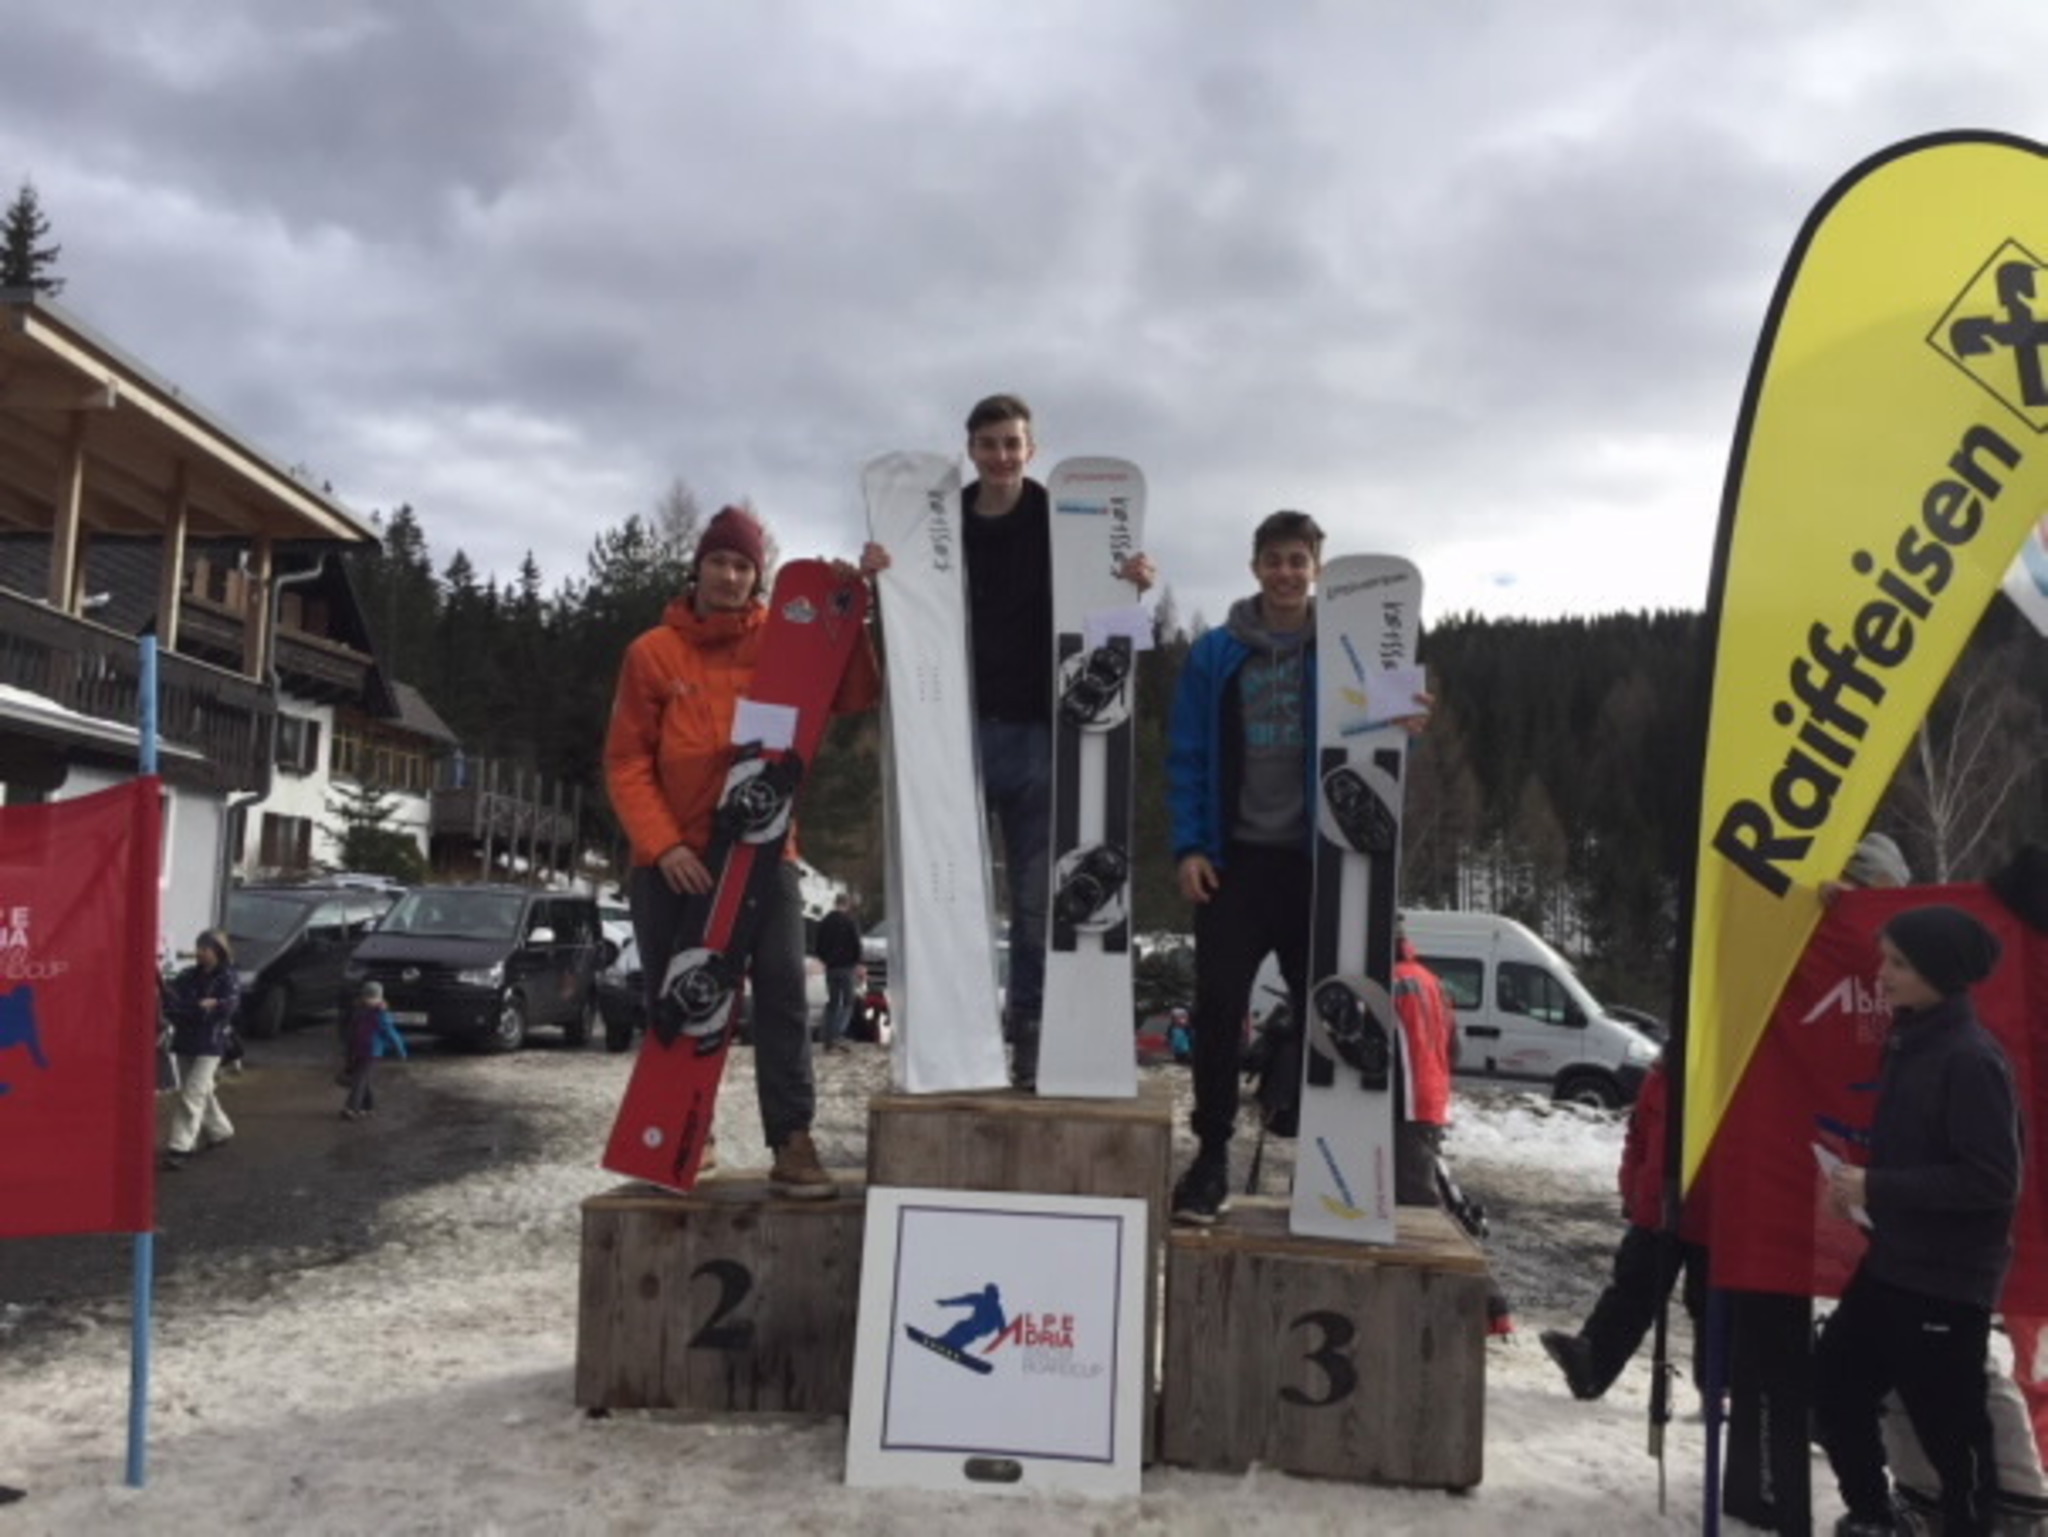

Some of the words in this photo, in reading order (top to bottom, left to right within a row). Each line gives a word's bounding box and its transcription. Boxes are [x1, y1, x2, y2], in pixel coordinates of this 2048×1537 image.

[1712, 423, 2023, 899] Raiffeisen
[687, 1258, 756, 1350] 2
[1279, 1310, 1358, 1407] 3
